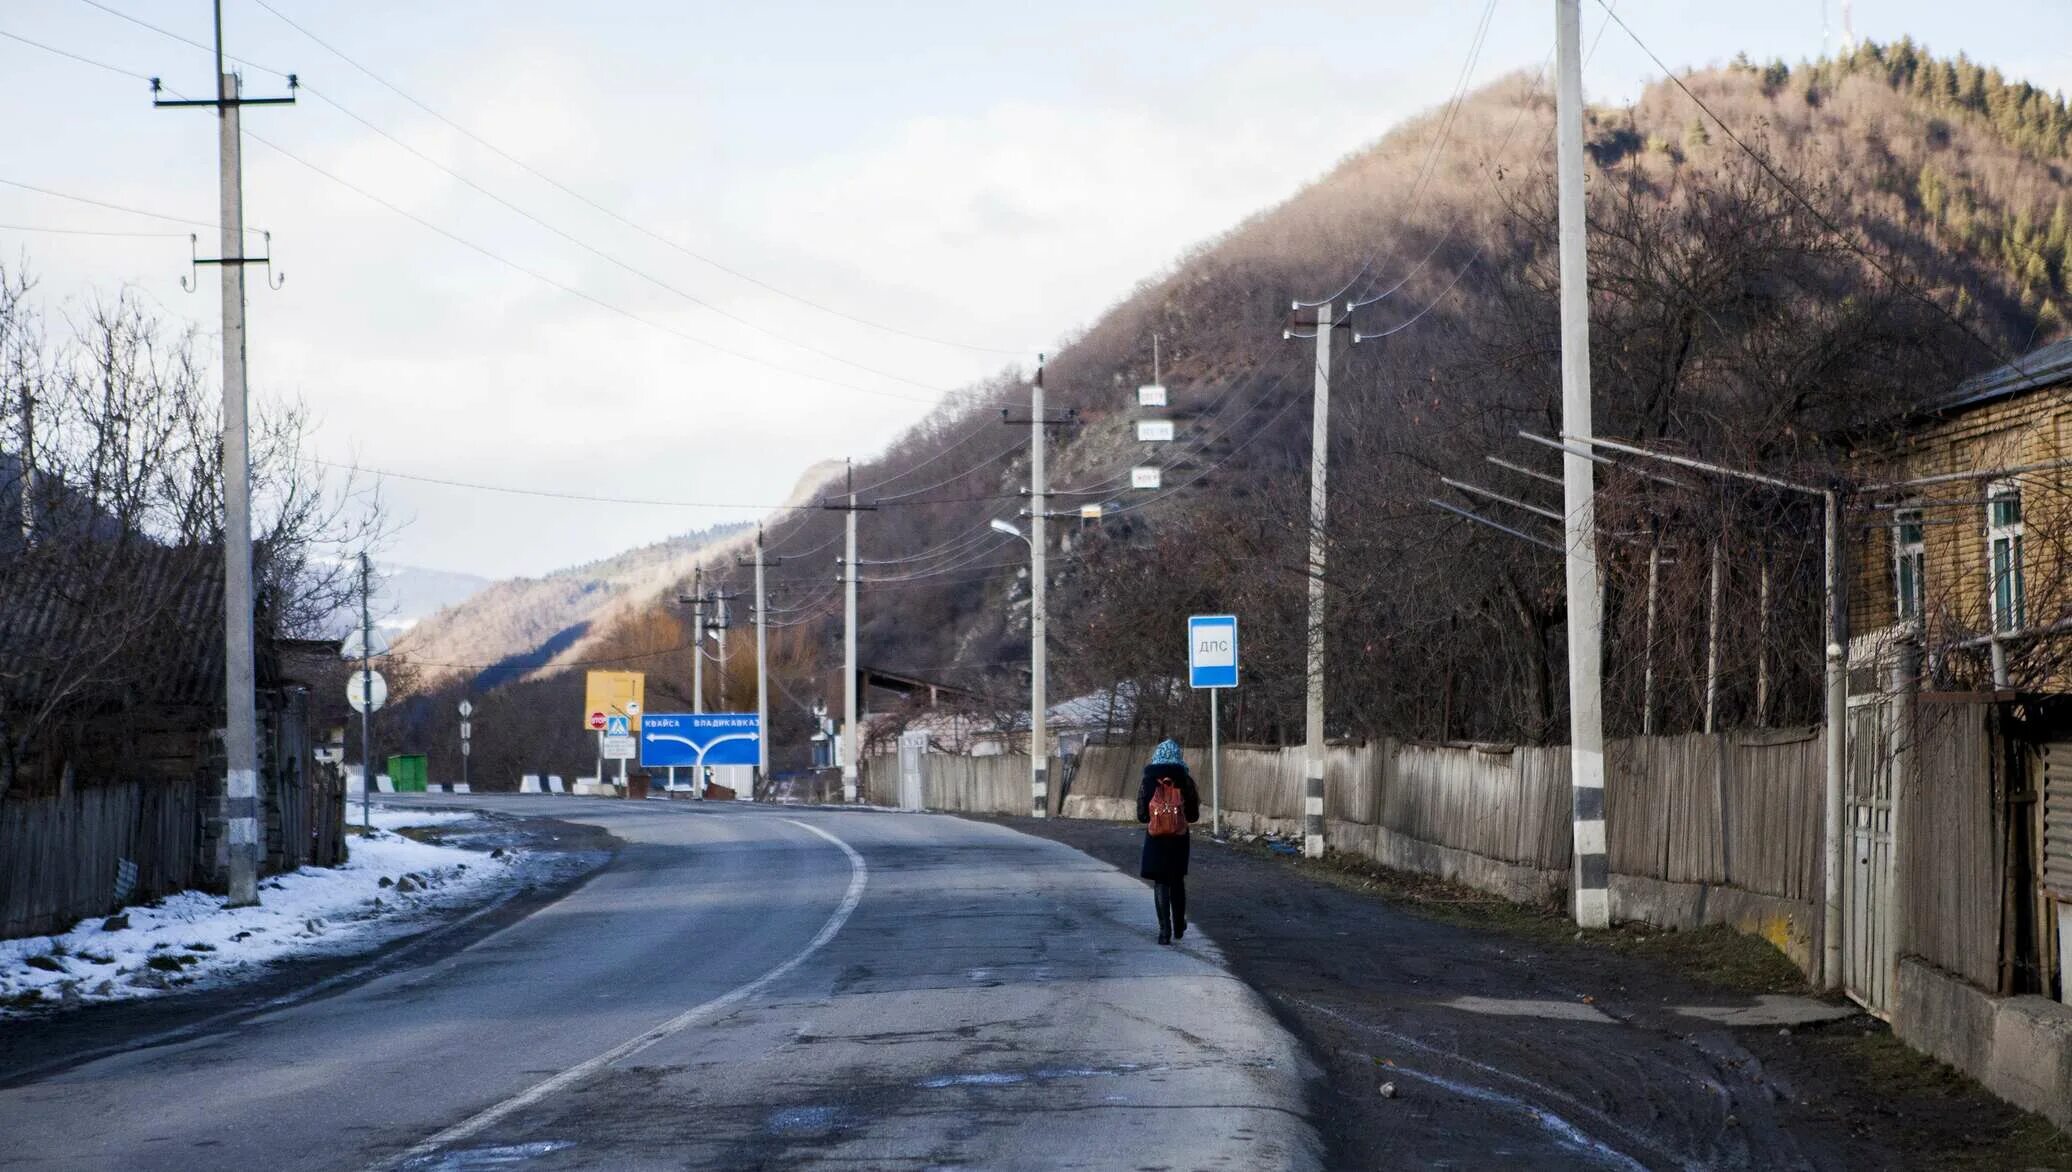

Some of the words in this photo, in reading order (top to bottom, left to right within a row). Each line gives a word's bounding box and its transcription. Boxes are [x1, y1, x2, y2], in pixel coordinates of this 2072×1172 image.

[1200, 640, 1227, 653] ДПС
[592, 716, 606, 724] STOP
[645, 719, 680, 728] КВАЙСА
[693, 719, 760, 728] ВЛАДИКАВКАЗ
